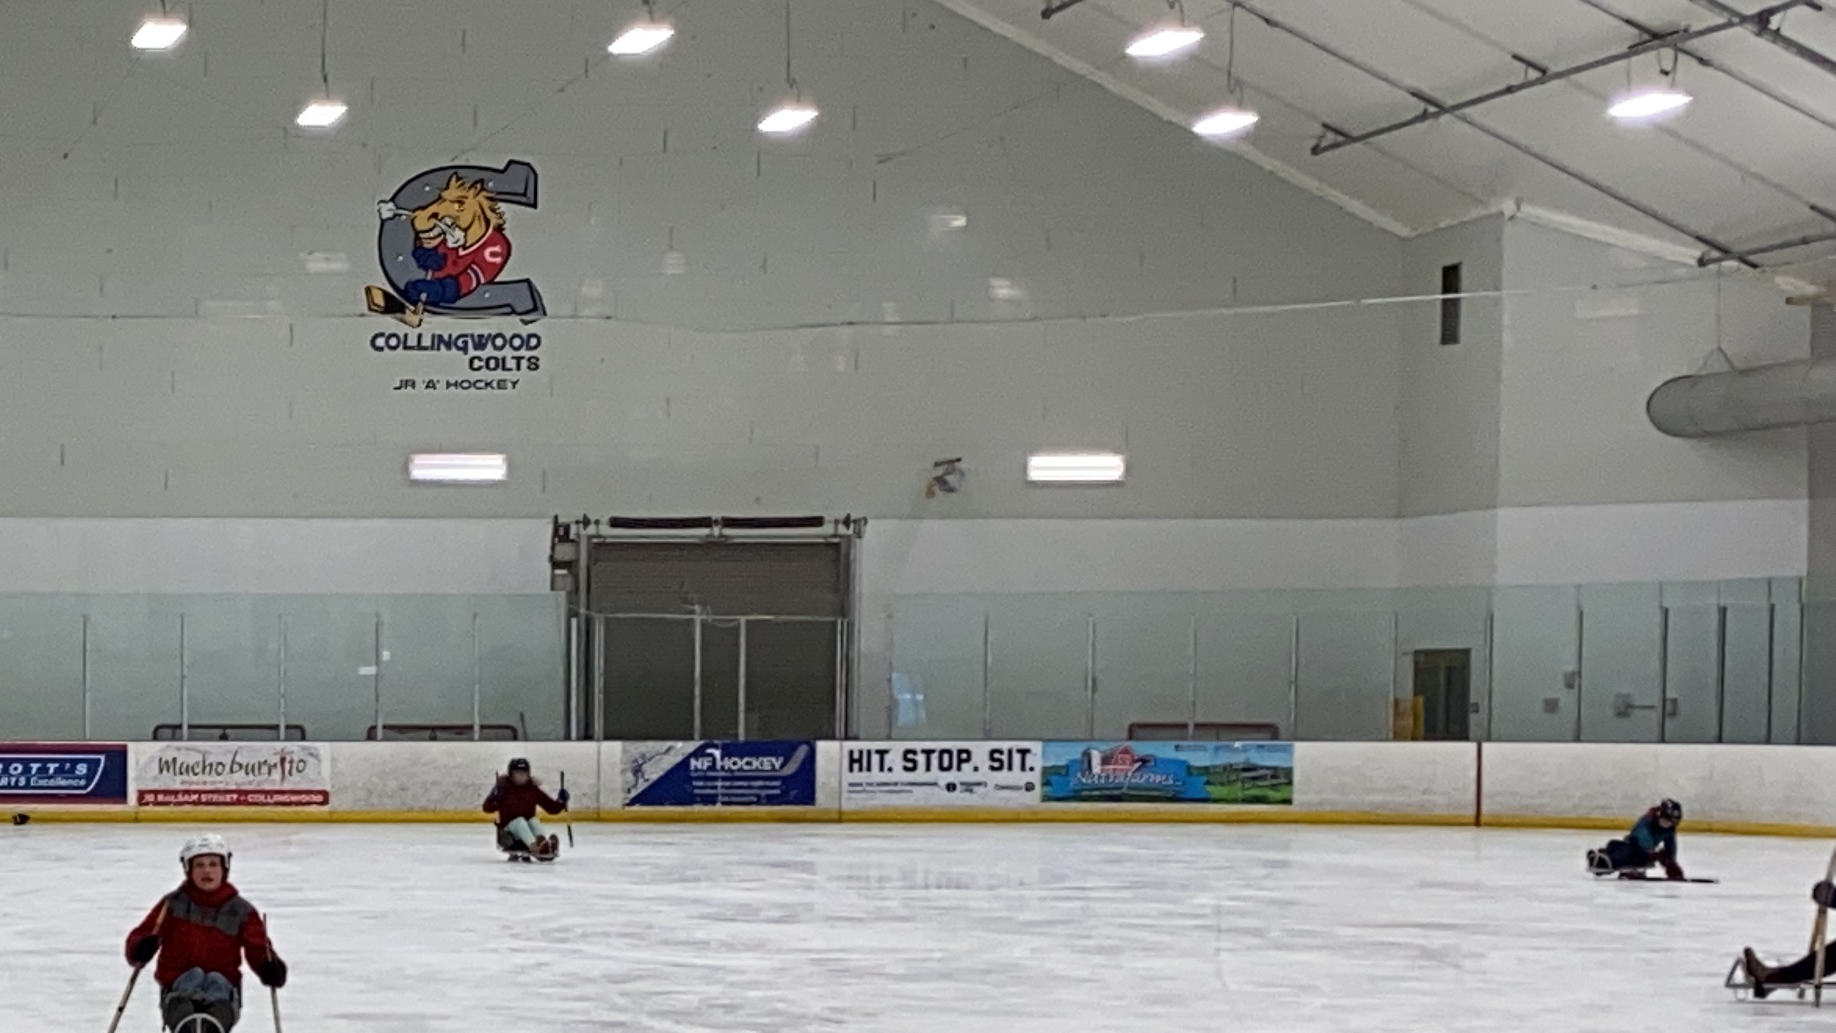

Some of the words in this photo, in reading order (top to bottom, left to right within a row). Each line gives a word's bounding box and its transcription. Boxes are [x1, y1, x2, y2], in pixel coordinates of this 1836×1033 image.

[370, 332, 542, 355] COLLINGWOOD
[469, 356, 540, 371] COLTS
[393, 379, 416, 390] JR
[445, 379, 521, 391] HOCKEY
[689, 757, 713, 771] NF
[715, 752, 784, 771] HOCKEY
[848, 748, 893, 773] HIT.
[902, 748, 979, 773] STOP.
[988, 748, 1035, 773] SIT.
[30, 775, 87, 787] Excellence
